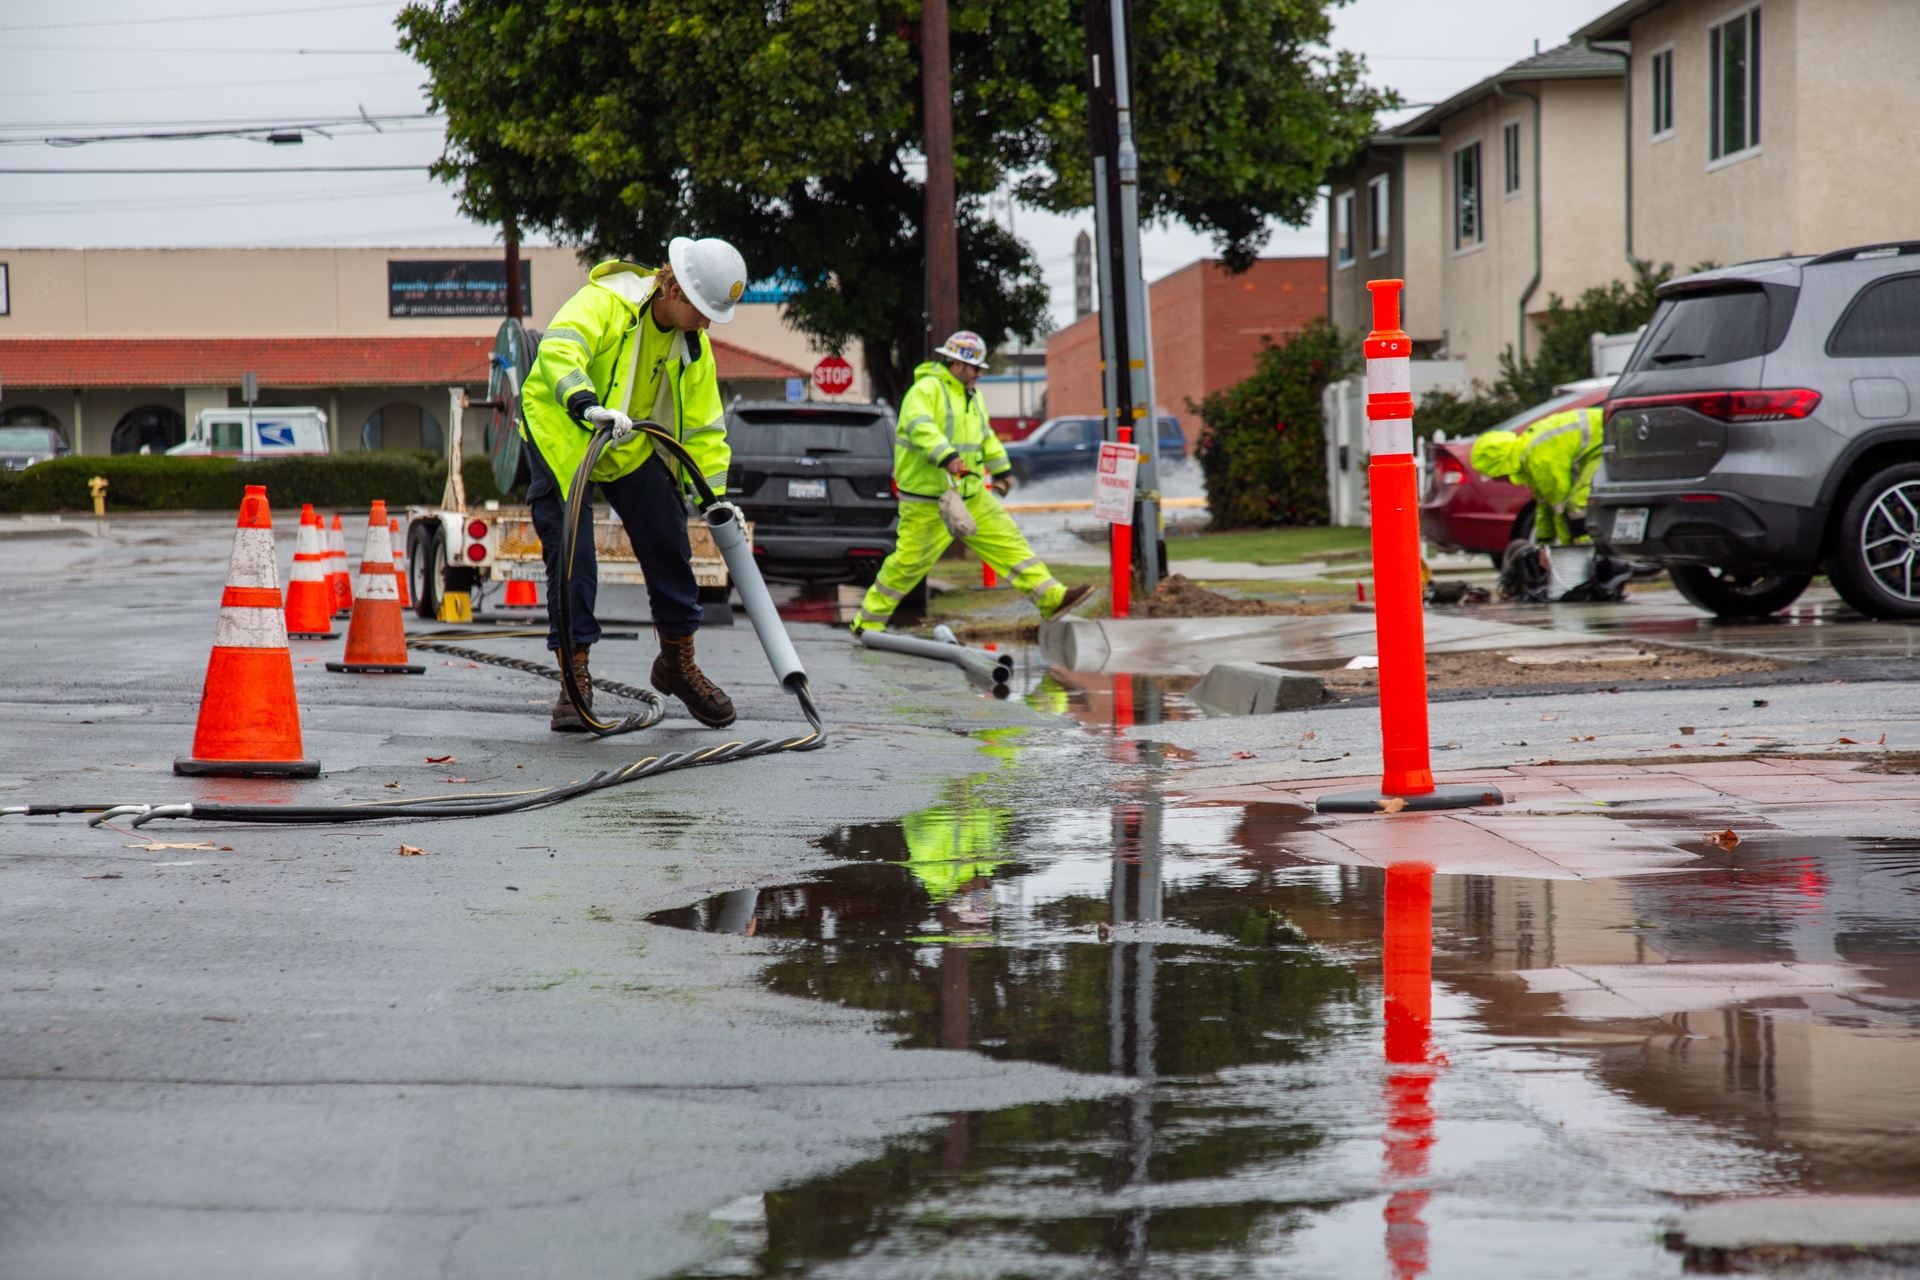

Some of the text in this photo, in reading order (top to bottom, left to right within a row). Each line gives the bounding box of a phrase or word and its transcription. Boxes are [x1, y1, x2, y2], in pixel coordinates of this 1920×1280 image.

[814, 366, 851, 385] STOP
[1101, 457, 1115, 474] NO
[1101, 476, 1130, 491] PARKING
